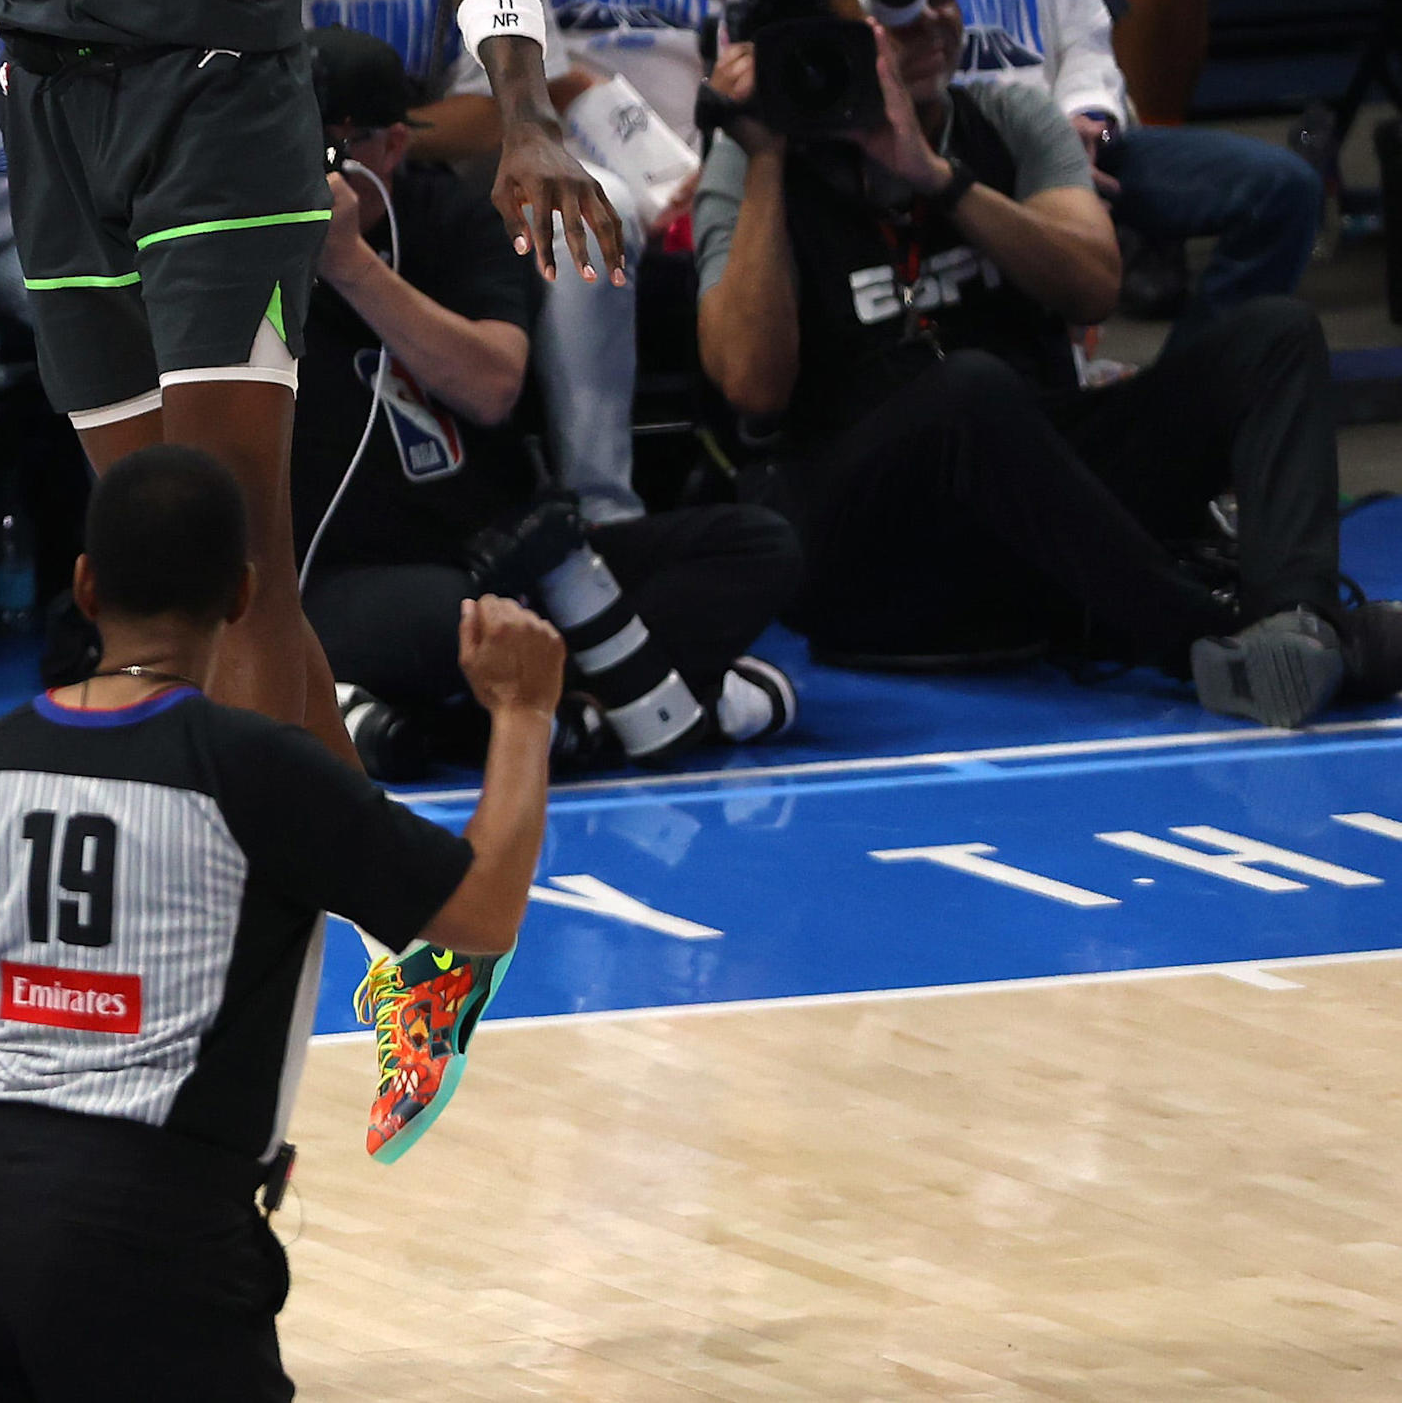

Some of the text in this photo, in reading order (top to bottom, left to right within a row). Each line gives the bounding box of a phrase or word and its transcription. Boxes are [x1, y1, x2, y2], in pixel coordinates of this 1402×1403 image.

[493, 13, 519, 29] NR
[22, 809, 117, 948] 19
[12, 976, 127, 1018] Emirates
